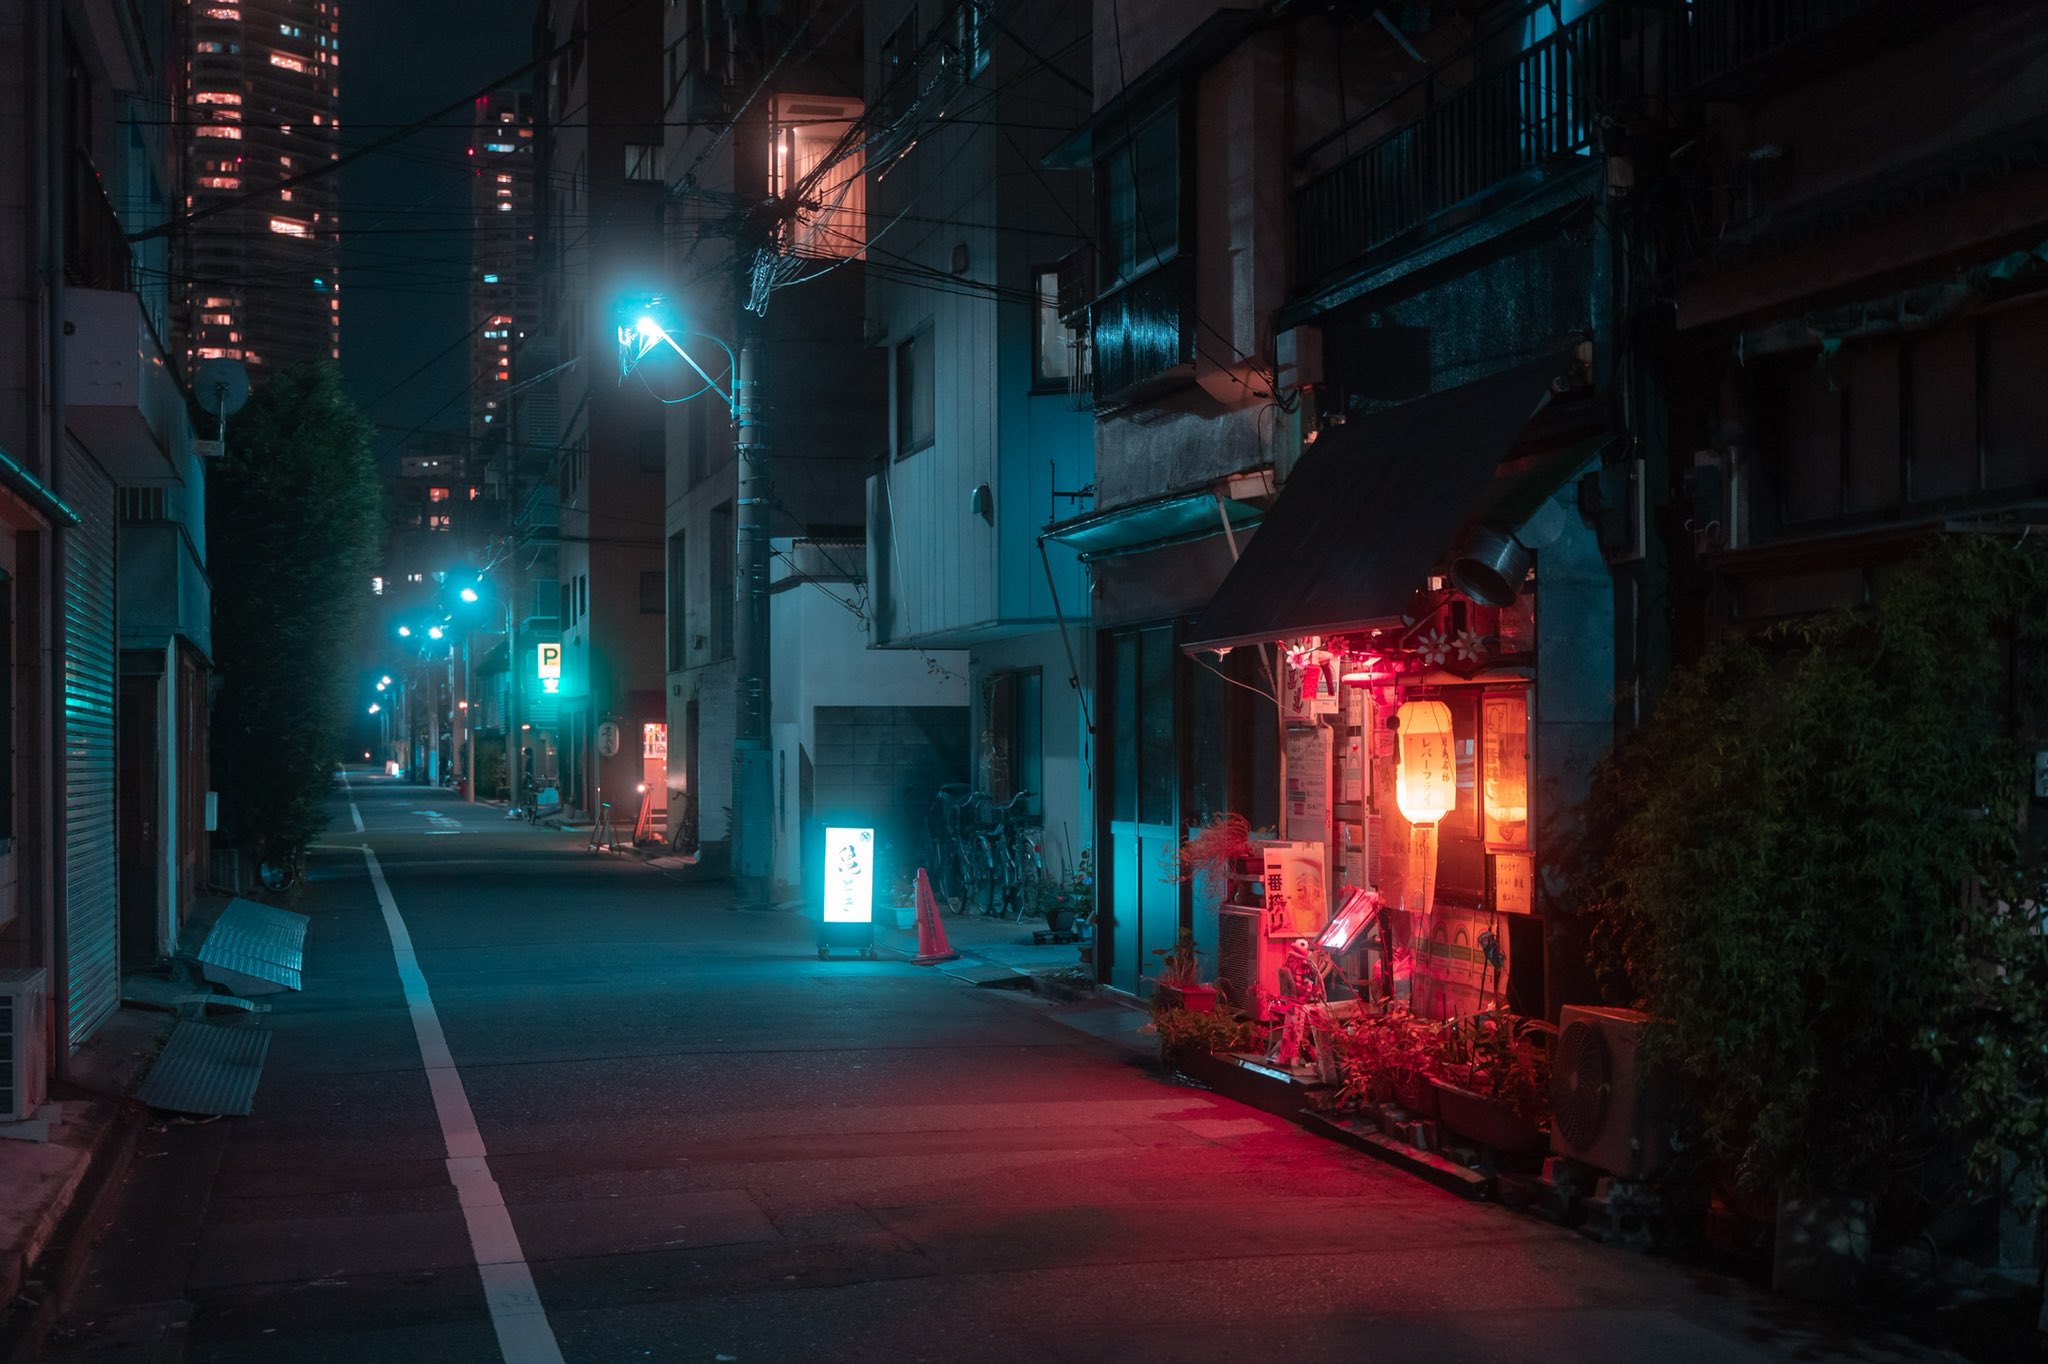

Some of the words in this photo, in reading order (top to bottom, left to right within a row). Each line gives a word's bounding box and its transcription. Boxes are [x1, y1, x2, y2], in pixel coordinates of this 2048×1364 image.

[544, 648, 558, 665] P
[1421, 738, 1432, 807] レバーフライ
[1267, 864, 1285, 932] 一番搾り
